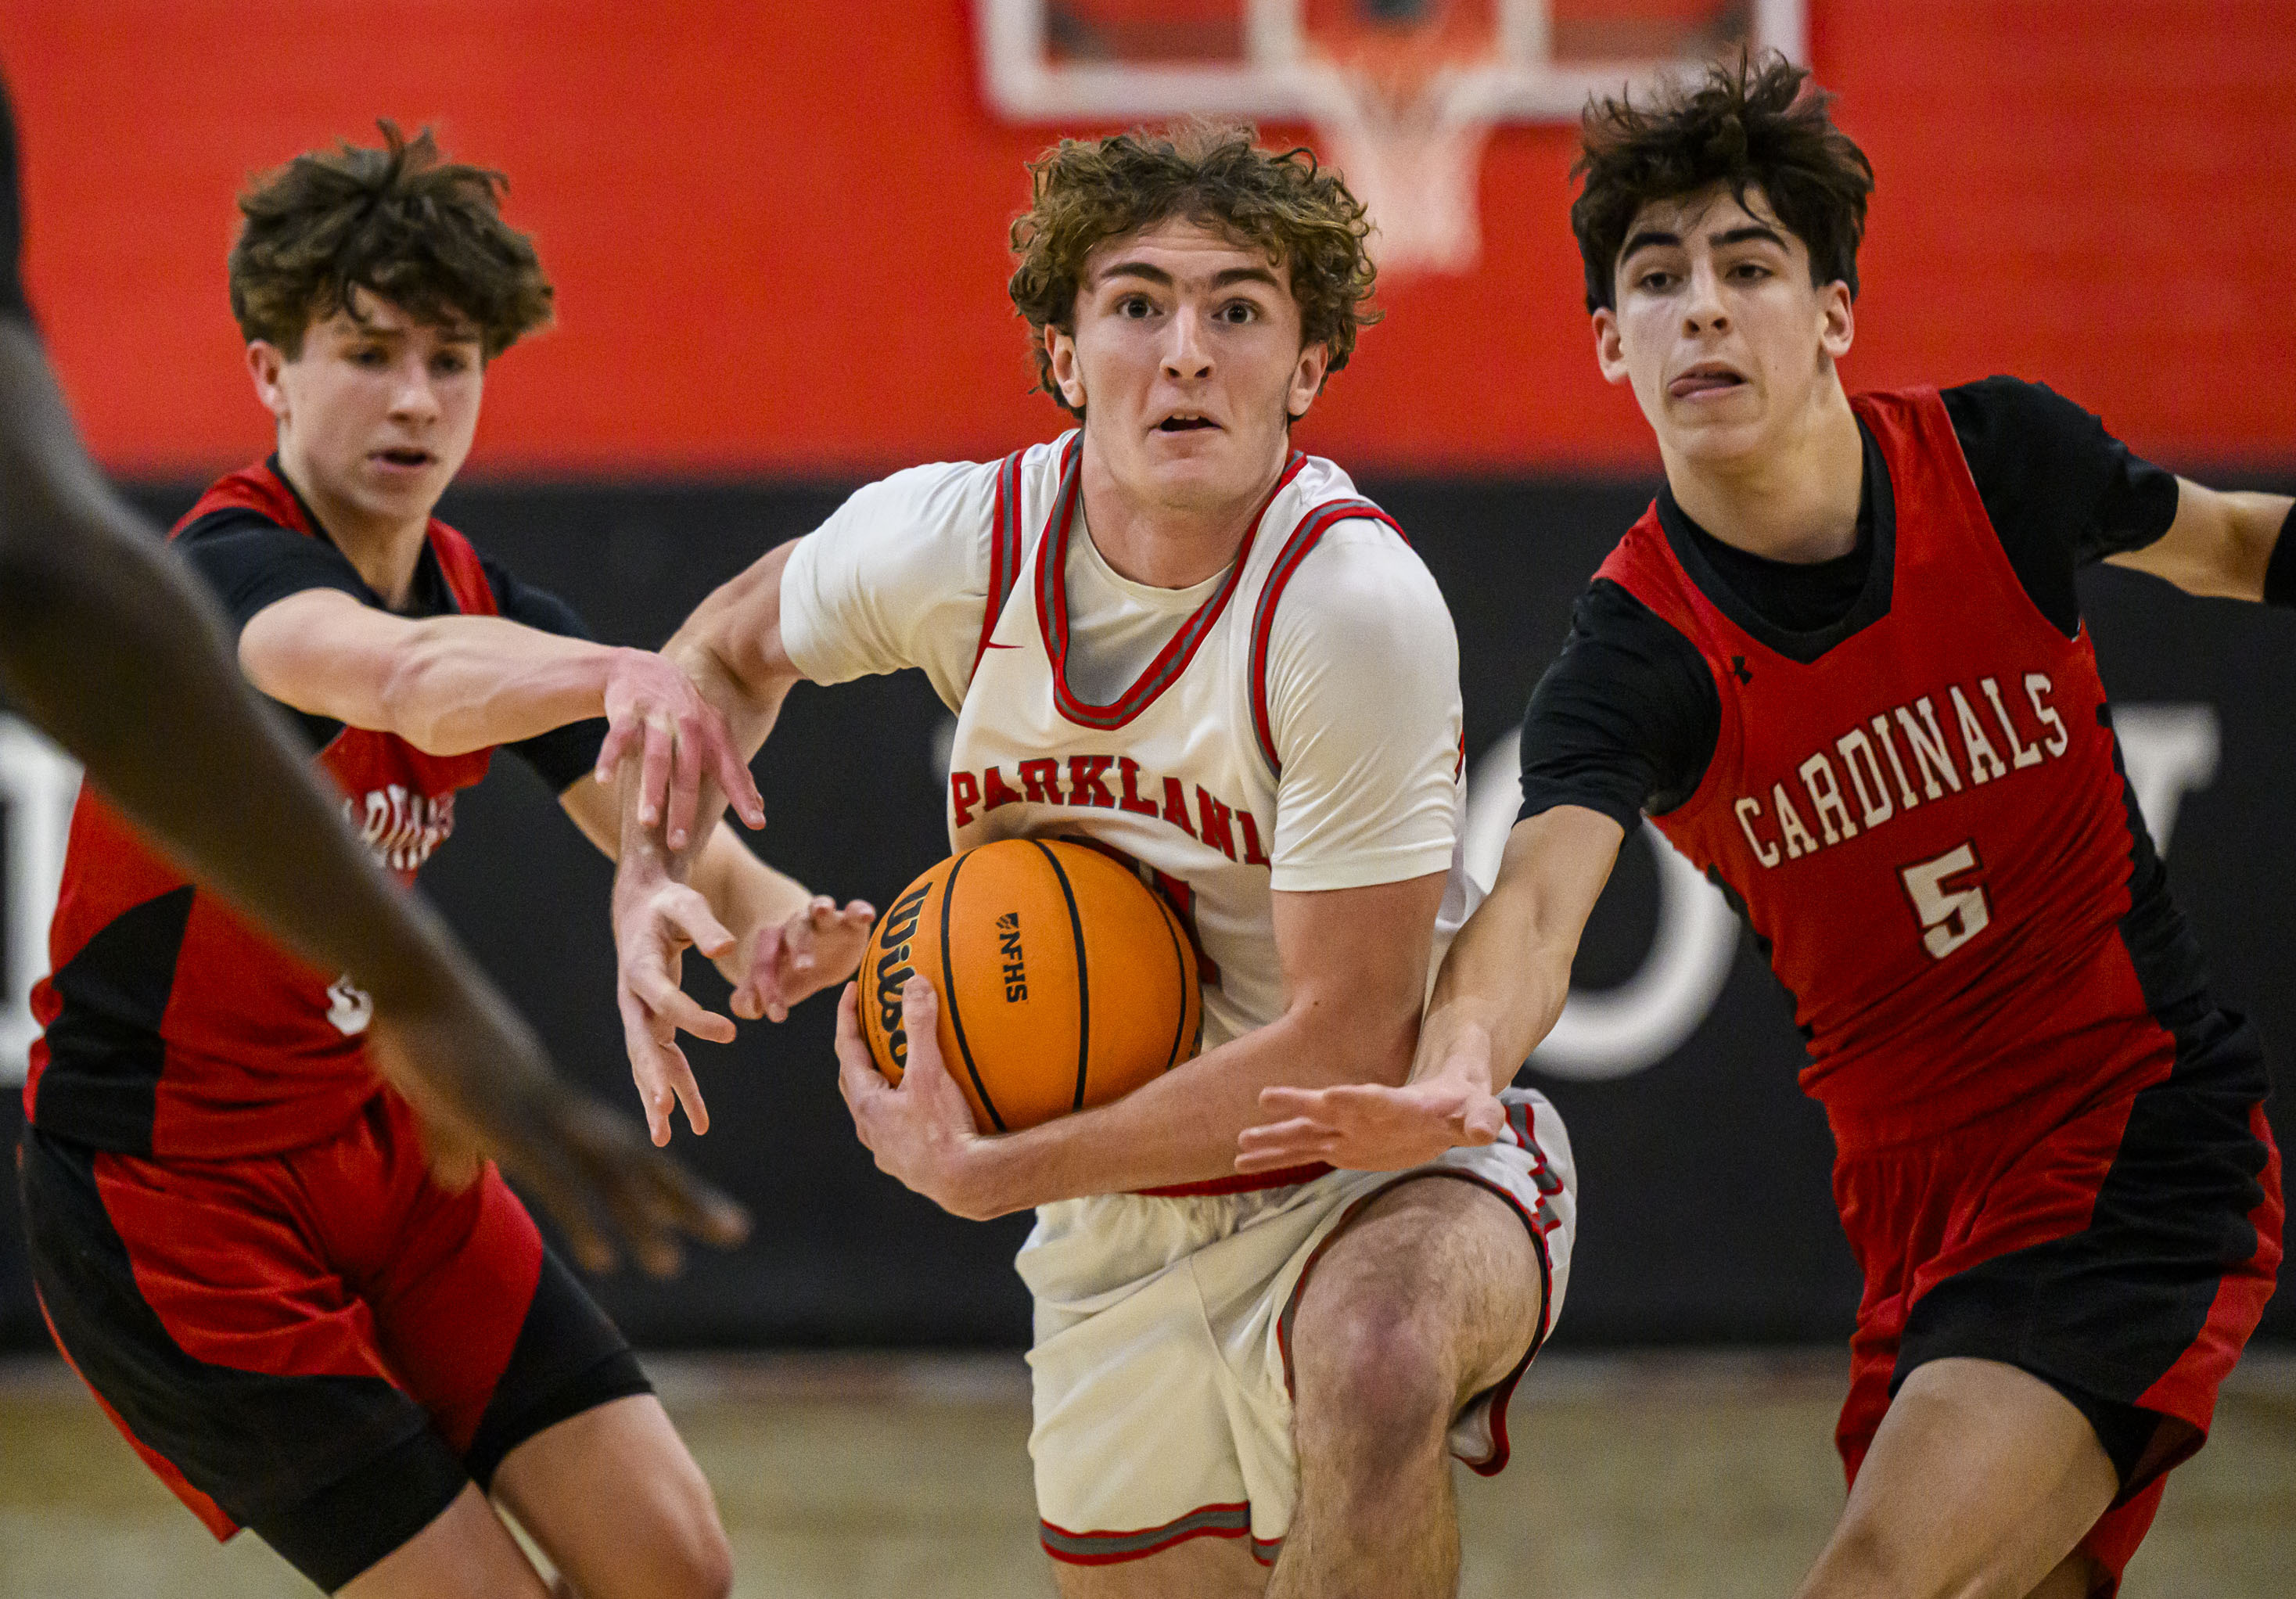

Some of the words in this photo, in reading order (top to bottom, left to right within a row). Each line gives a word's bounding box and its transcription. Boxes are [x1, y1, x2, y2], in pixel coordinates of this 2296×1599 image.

[1733, 670, 2071, 871] CARDINALS
[876, 882, 933, 1069] Wilso
[998, 930, 1028, 1004] NFHS
[1898, 838, 1992, 961] 5
